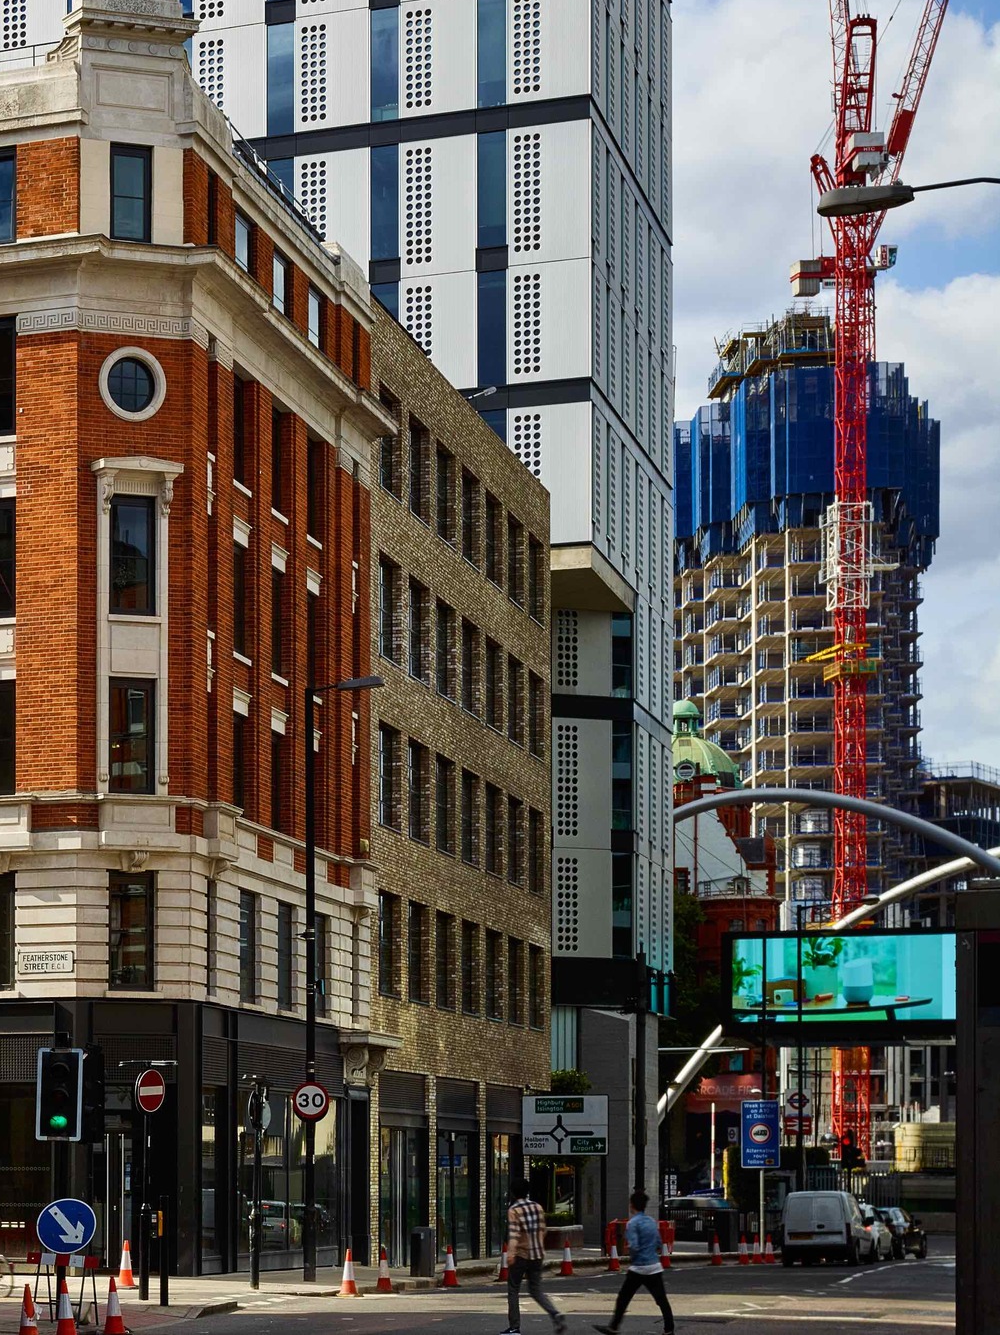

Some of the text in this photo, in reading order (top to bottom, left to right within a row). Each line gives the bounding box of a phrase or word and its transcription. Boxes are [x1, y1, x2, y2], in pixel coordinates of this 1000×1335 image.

[22, 954, 68, 962] FEATHERSTONE
[697, 1085, 736, 1095] RCADE
[298, 1092, 324, 1108] 30
